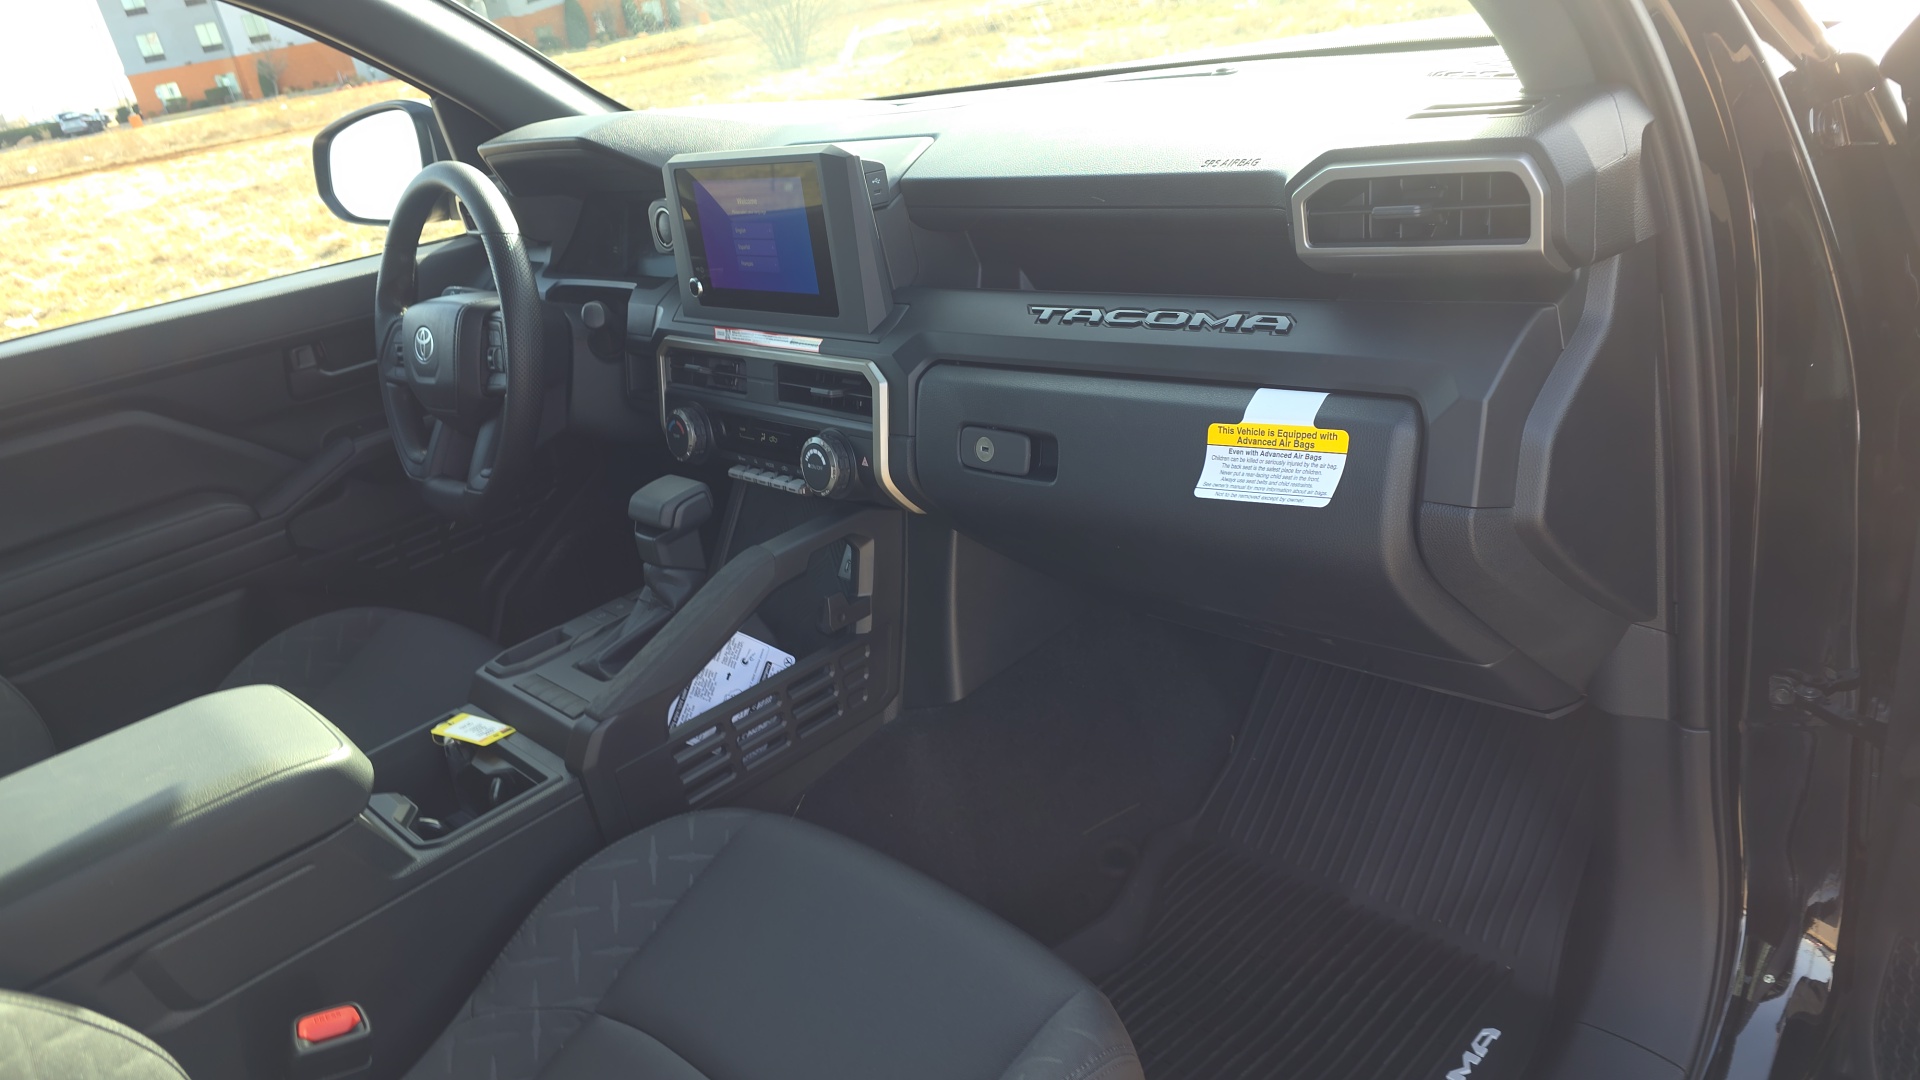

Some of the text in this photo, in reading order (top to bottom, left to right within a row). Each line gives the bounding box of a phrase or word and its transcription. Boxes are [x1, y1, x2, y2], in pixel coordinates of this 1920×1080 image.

[1220, 158, 1262, 167] AIRBAG
[1027, 304, 1297, 336] TACOMA
[1218, 425, 1338, 441] This Vehicle is Equipped with
[1237, 437, 1315, 451] Advanced Air Bags
[1260, 451, 1292, 459] Advanced
[1305, 453, 1322, 462] Bags
[1287, 460, 1303, 468] injured
